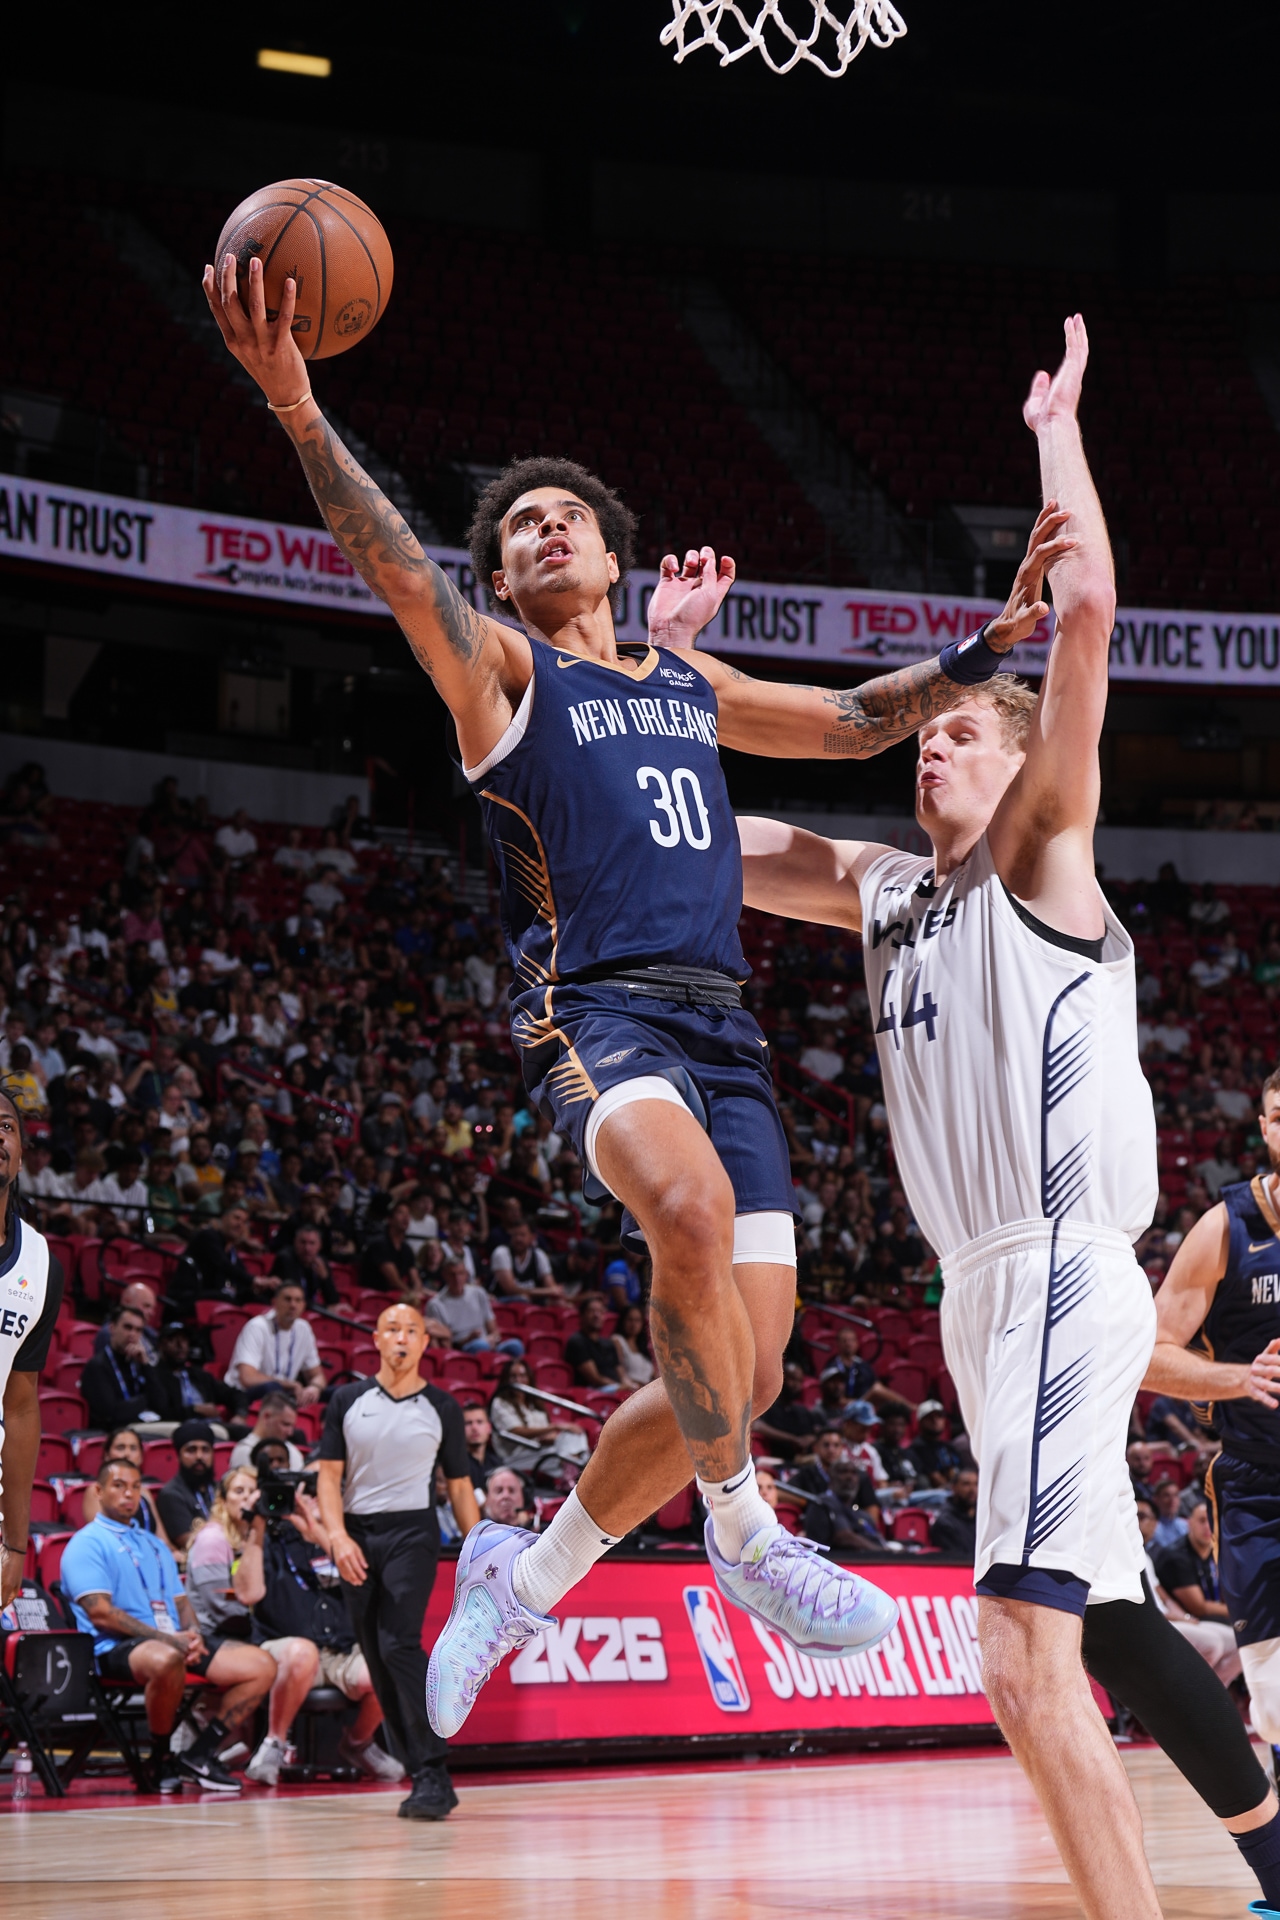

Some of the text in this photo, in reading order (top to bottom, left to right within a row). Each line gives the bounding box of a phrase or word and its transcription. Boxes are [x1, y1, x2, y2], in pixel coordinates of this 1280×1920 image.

[338, 138, 389, 172] 213
[902, 190, 952, 221] 214
[47, 495, 154, 563] TRUST
[199, 523, 272, 565] TED
[720, 594, 822, 645] TRUST
[846, 603, 918, 639] TED
[1108, 620, 1280, 670] RVICE YOU
[567, 699, 627, 746] NEW
[636, 766, 712, 851] 30
[886, 827, 933, 855] 10
[875, 961, 939, 1051] 44
[7, 1288, 34, 1303] sezzle
[0, 1308, 29, 1339] ES
[46, 1645, 72, 1694] 13
[509, 1616, 668, 1684] 2K26
